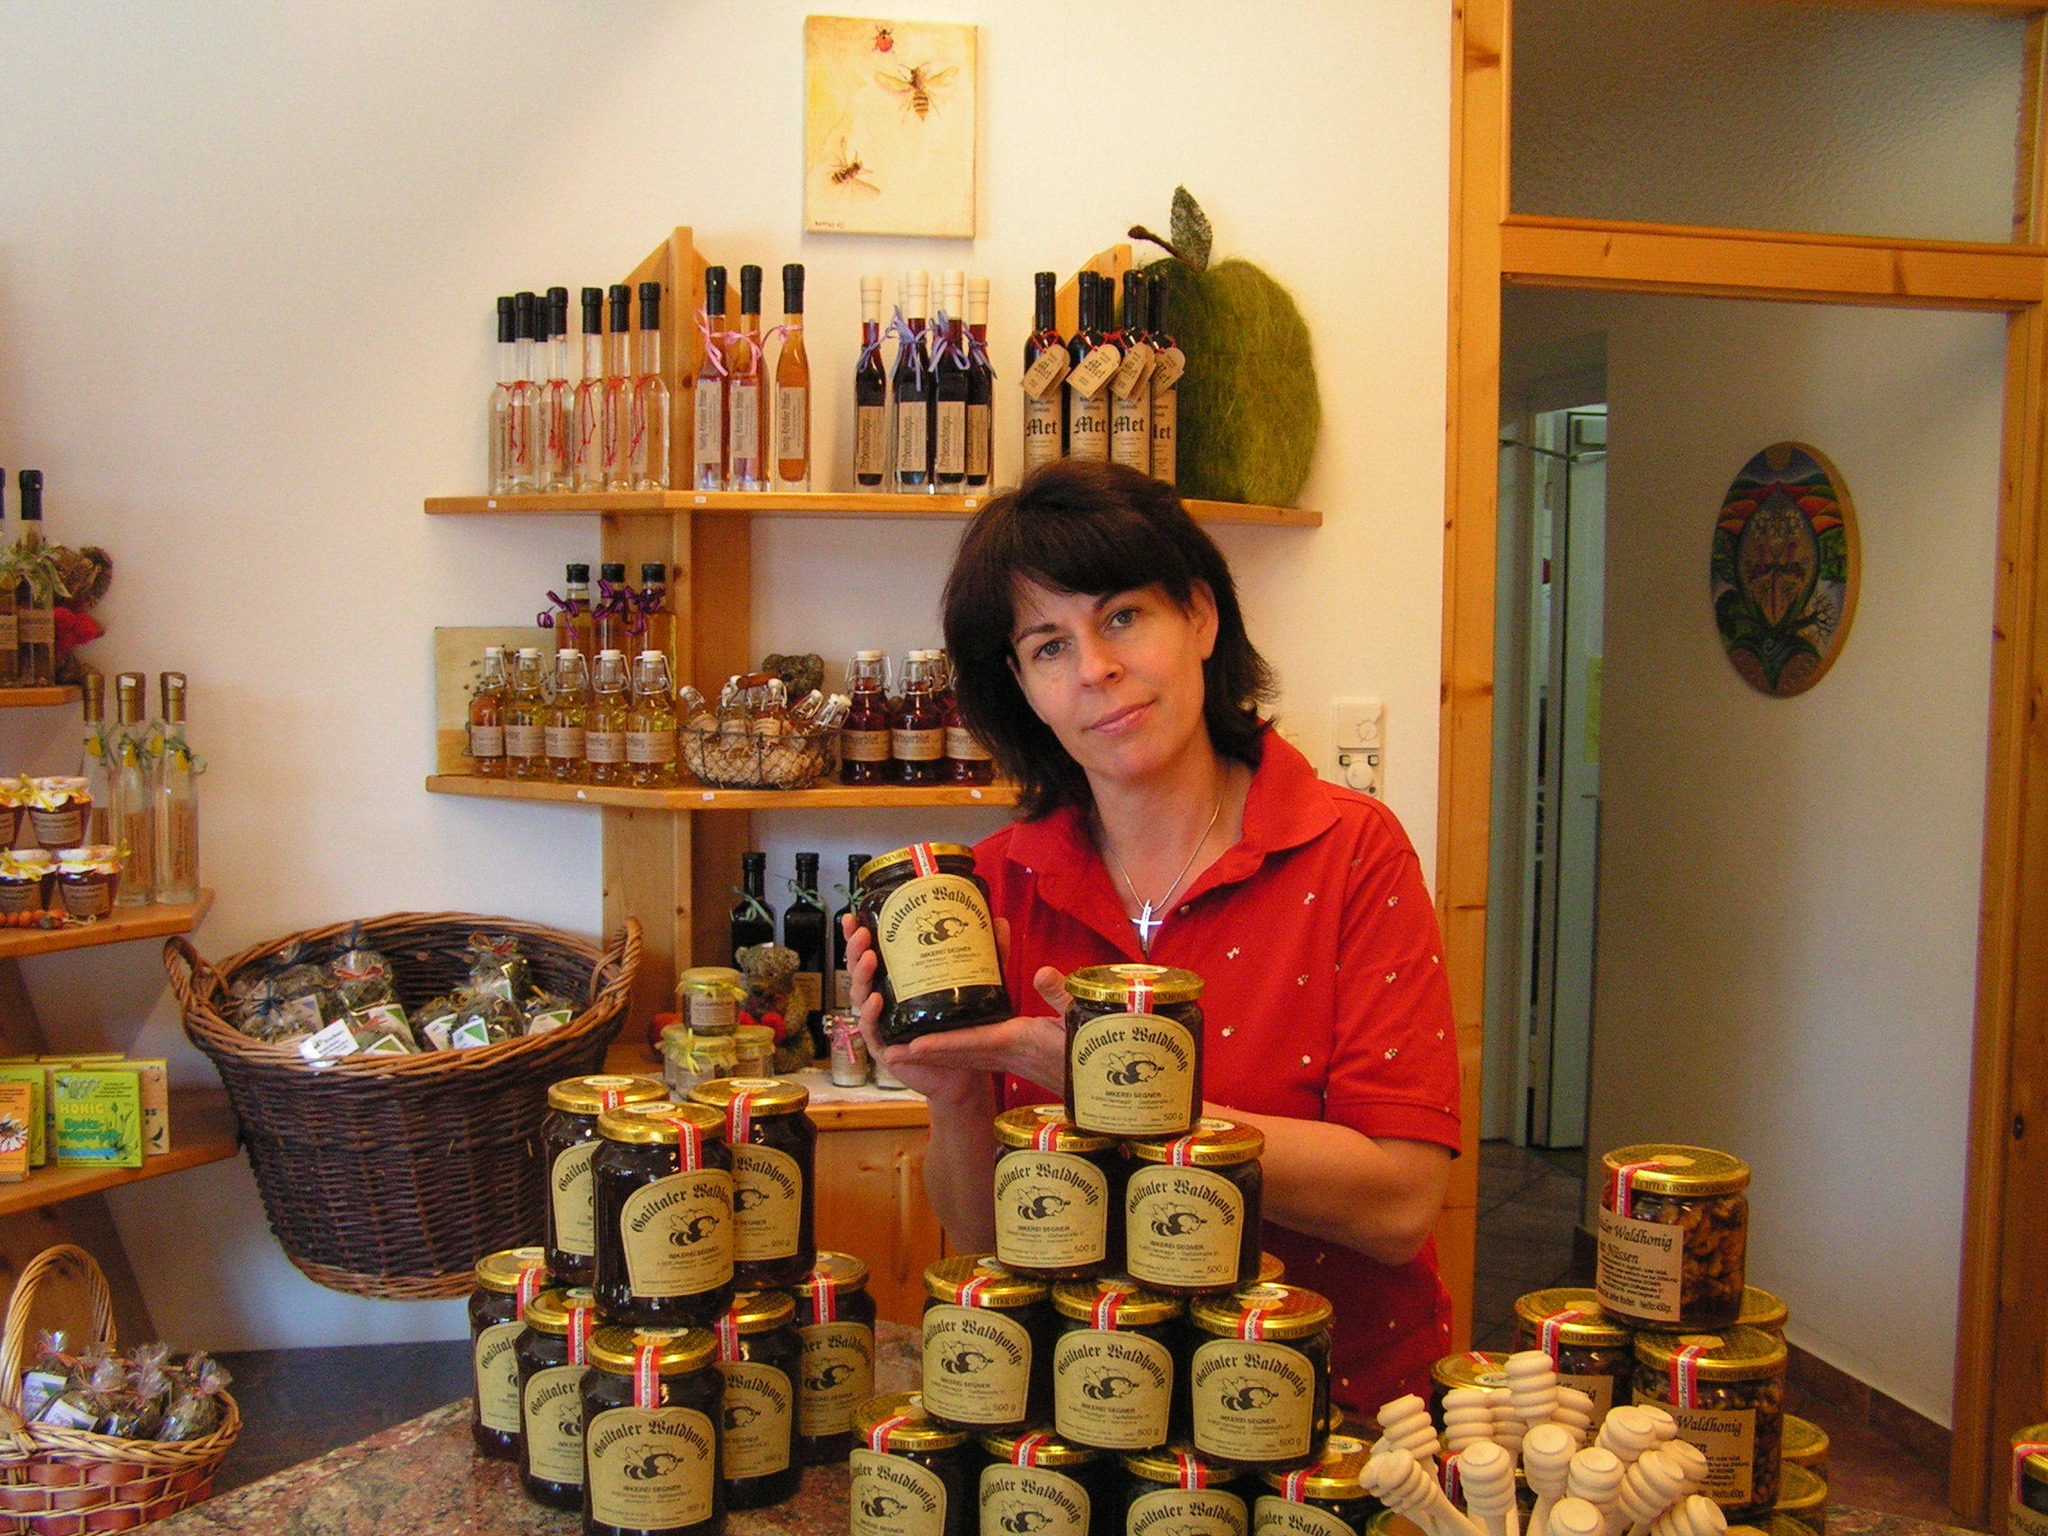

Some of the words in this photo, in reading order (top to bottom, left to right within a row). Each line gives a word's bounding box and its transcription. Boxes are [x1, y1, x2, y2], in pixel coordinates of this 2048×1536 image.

[1026, 418, 1058, 437] Met
[1073, 416, 1106, 434] Met
[1113, 415, 1145, 434] Met
[885, 892, 928, 943] Gailtaler
[932, 885, 988, 931] Waldhonig
[1078, 1029, 1126, 1066] Gailtaler
[1131, 1026, 1189, 1073] Waldhonig
[60, 1103, 104, 1114] HONIG
[1163, 1112, 1177, 1122] 500
[736, 1156, 795, 1199] Waldhonig
[1036, 1162, 1100, 1206] Waldhonig
[630, 1190, 687, 1233] Gailtaler
[1174, 1179, 1236, 1226] Waldhonig
[1613, 1225, 1673, 1252] Waldhonig
[1206, 1266, 1222, 1274] 500
[961, 1319, 1023, 1366] Waldhonig
[1057, 1344, 1102, 1376] Gailtaler
[1106, 1343, 1166, 1389] Waldhonig
[1243, 1352, 1306, 1398] Waldhonig
[531, 1381, 577, 1417] Gailtaler
[728, 1375, 787, 1415] Waldhonig
[592, 1421, 643, 1459] Gailtaler
[648, 1420, 711, 1461] Waldhonig
[1676, 1415, 1743, 1438] Waldhonig
[877, 1463, 938, 1513] Waldhonig
[1021, 1478, 1081, 1525] Waldhonig
